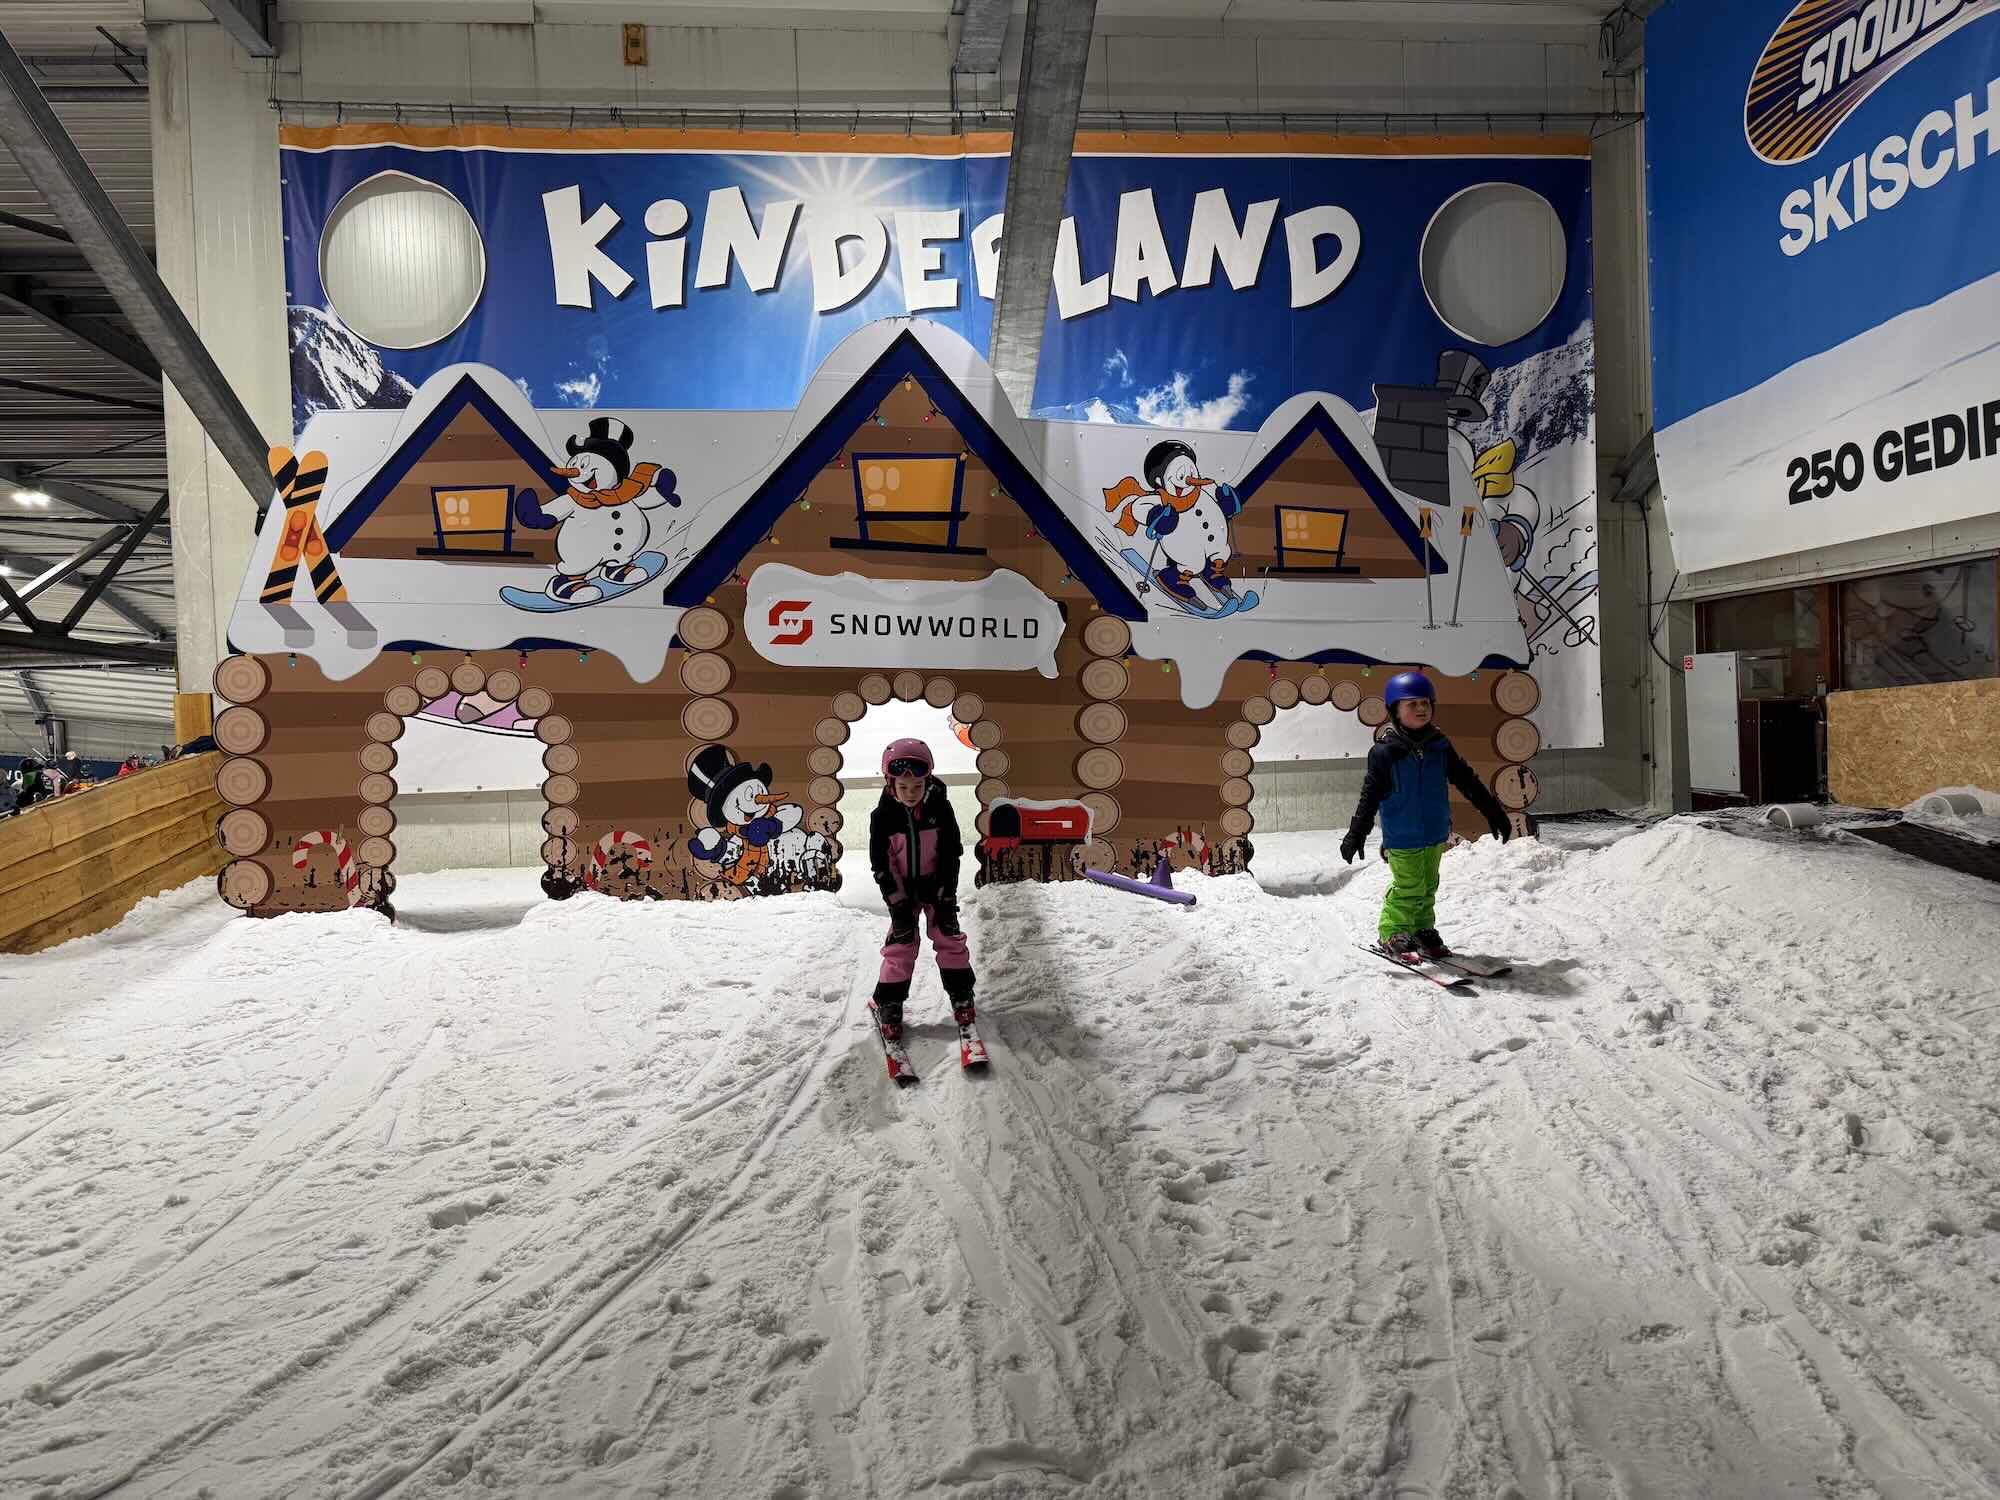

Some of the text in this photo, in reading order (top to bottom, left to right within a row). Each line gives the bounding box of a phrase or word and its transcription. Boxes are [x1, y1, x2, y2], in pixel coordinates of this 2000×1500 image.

[1779, 77, 2000, 257] SKISCH
[1786, 441, 1865, 506] 250
[829, 613, 1040, 640] SNOWWORLD
